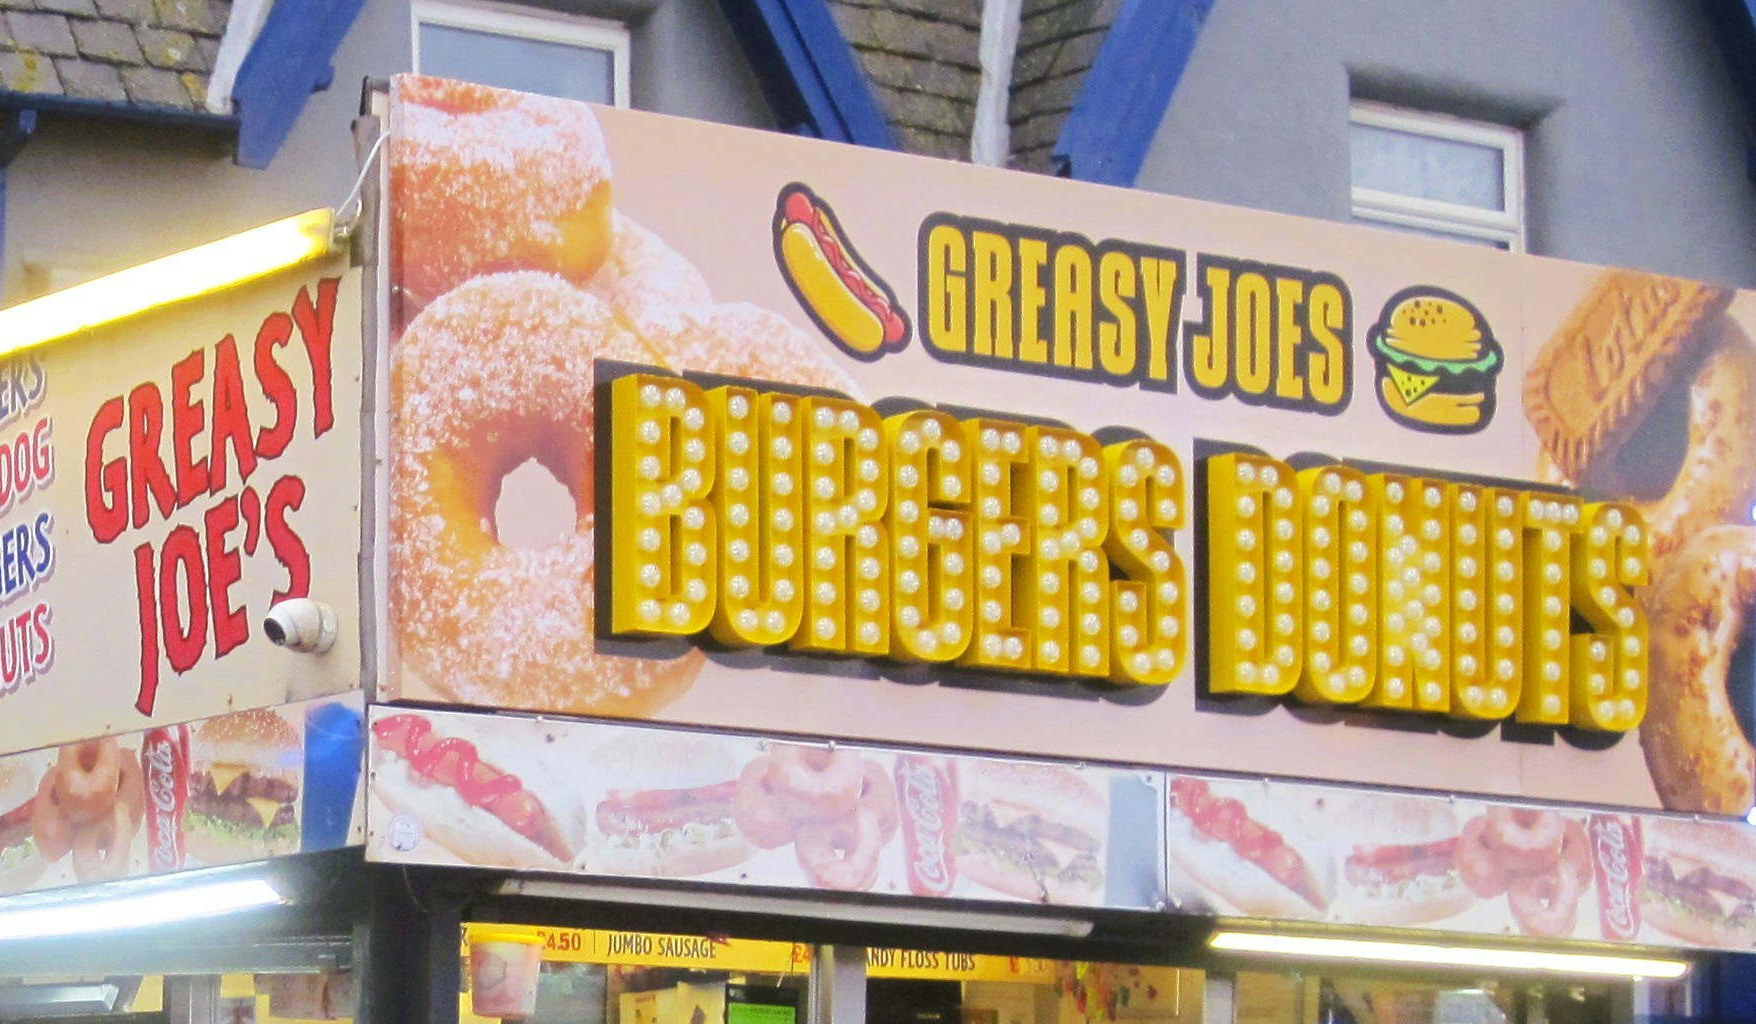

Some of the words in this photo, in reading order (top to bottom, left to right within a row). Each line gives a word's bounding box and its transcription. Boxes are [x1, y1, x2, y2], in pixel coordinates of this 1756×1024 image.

[84, 277, 342, 545] GREASY
[925, 224, 1177, 383] GREASY
[1192, 263, 1345, 405] JOES
[134, 474, 310, 717] JOE'S
[611, 372, 1184, 686] BURGERS
[1209, 450, 1648, 732] DONUTS
[608, 934, 652, 957] JUMBO
[657, 936, 716, 959] SAUSAGE
[900, 951, 939, 970] FLOSS
[945, 953, 976, 972] TUBS
